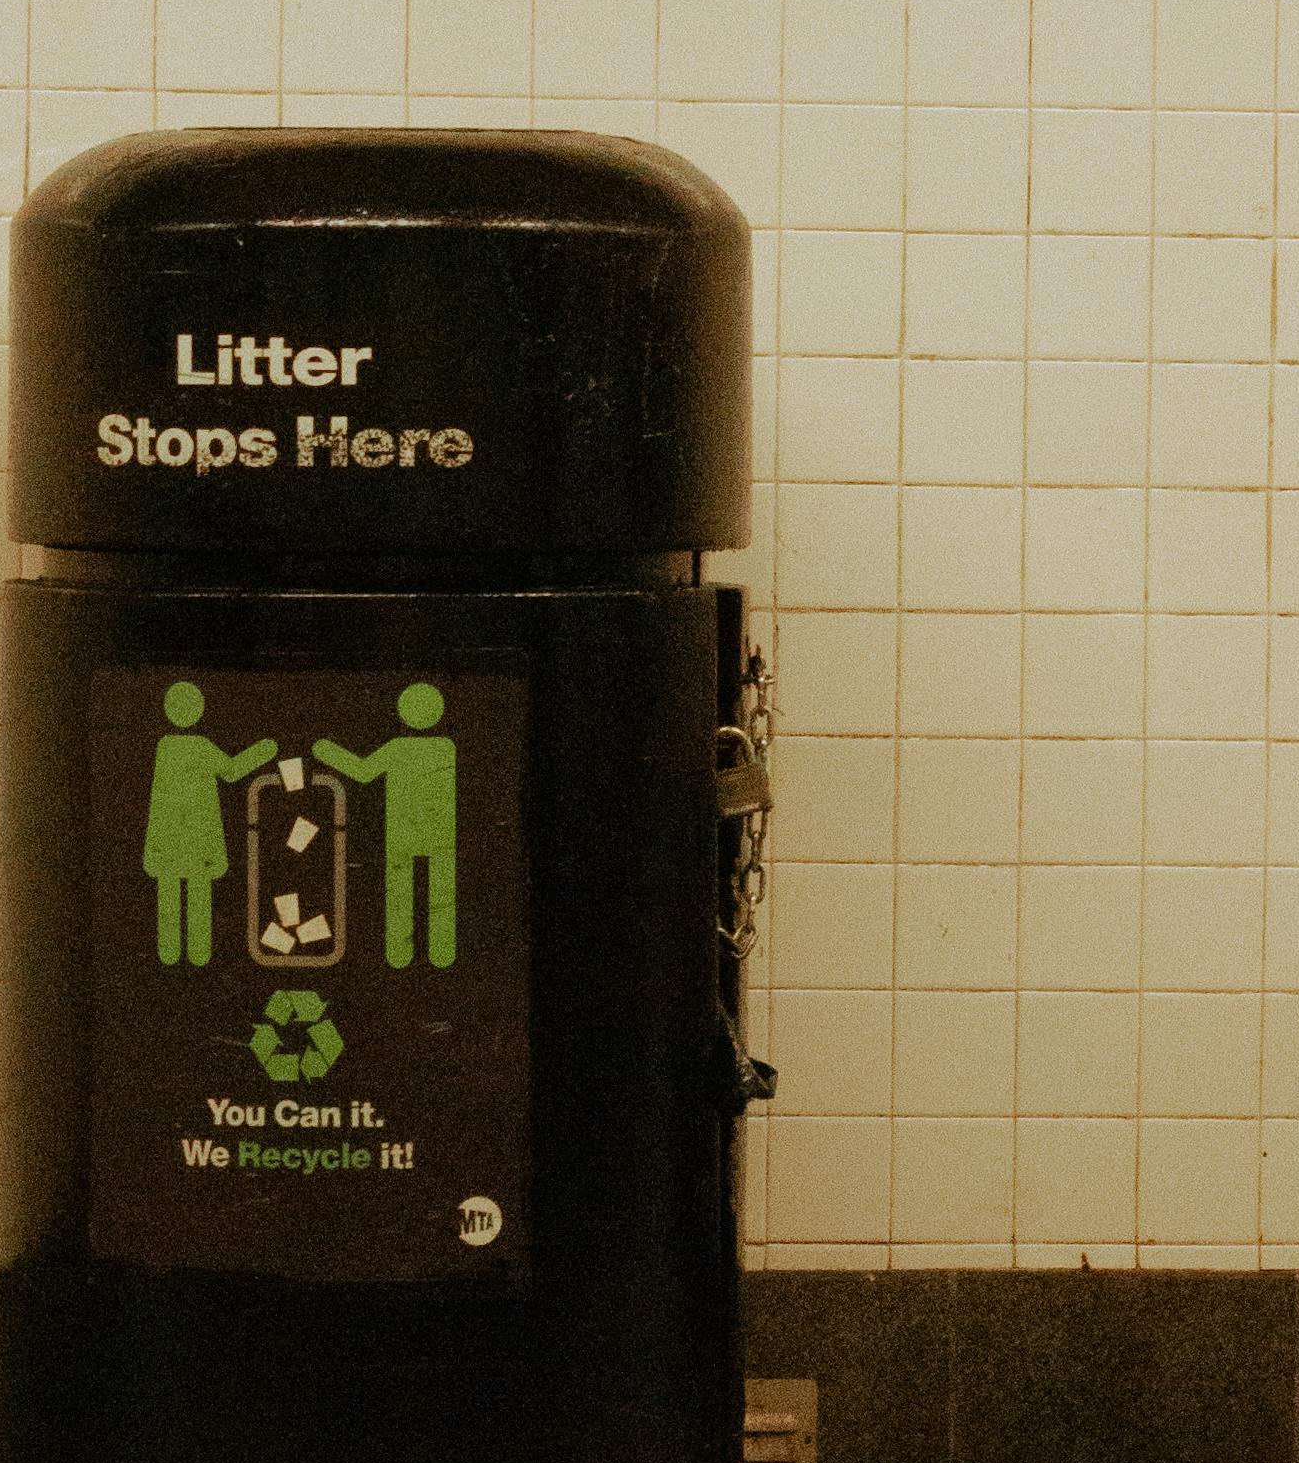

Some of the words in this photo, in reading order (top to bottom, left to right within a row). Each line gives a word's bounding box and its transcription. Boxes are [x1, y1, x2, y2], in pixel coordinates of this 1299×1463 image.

[177, 334, 372, 386] Litter
[97, 414, 278, 475] Stops
[296, 415, 474, 468] Here
[207, 1098, 266, 1127] You
[274, 1099, 341, 1127] Can
[351, 1100, 385, 1127] it.
[182, 1139, 229, 1167] We
[238, 1141, 372, 1174] Recycle
[380, 1141, 414, 1169] it!
[459, 1208, 494, 1234] MTA
